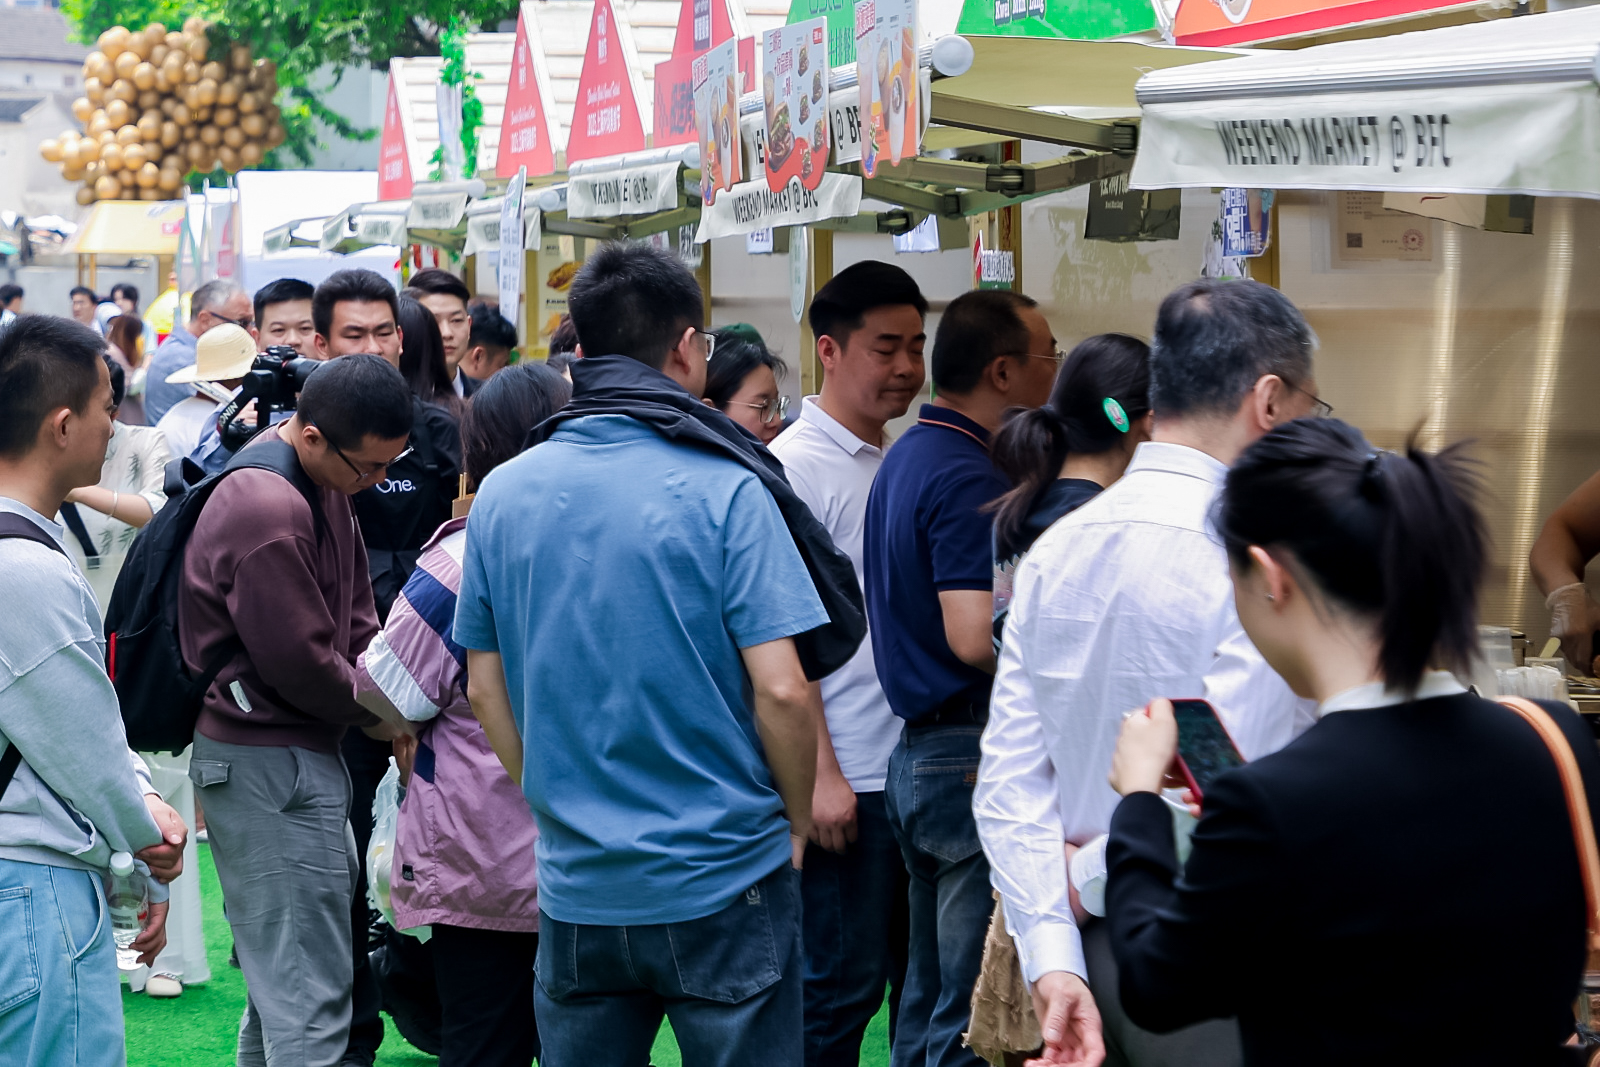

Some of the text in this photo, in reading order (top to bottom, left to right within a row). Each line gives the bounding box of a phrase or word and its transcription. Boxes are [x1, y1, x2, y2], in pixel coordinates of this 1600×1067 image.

[1215, 113, 1451, 173] WEEKEND MARKET @ BFC
[732, 193, 763, 224] WEEKEND
[763, 183, 791, 214] MARKET
